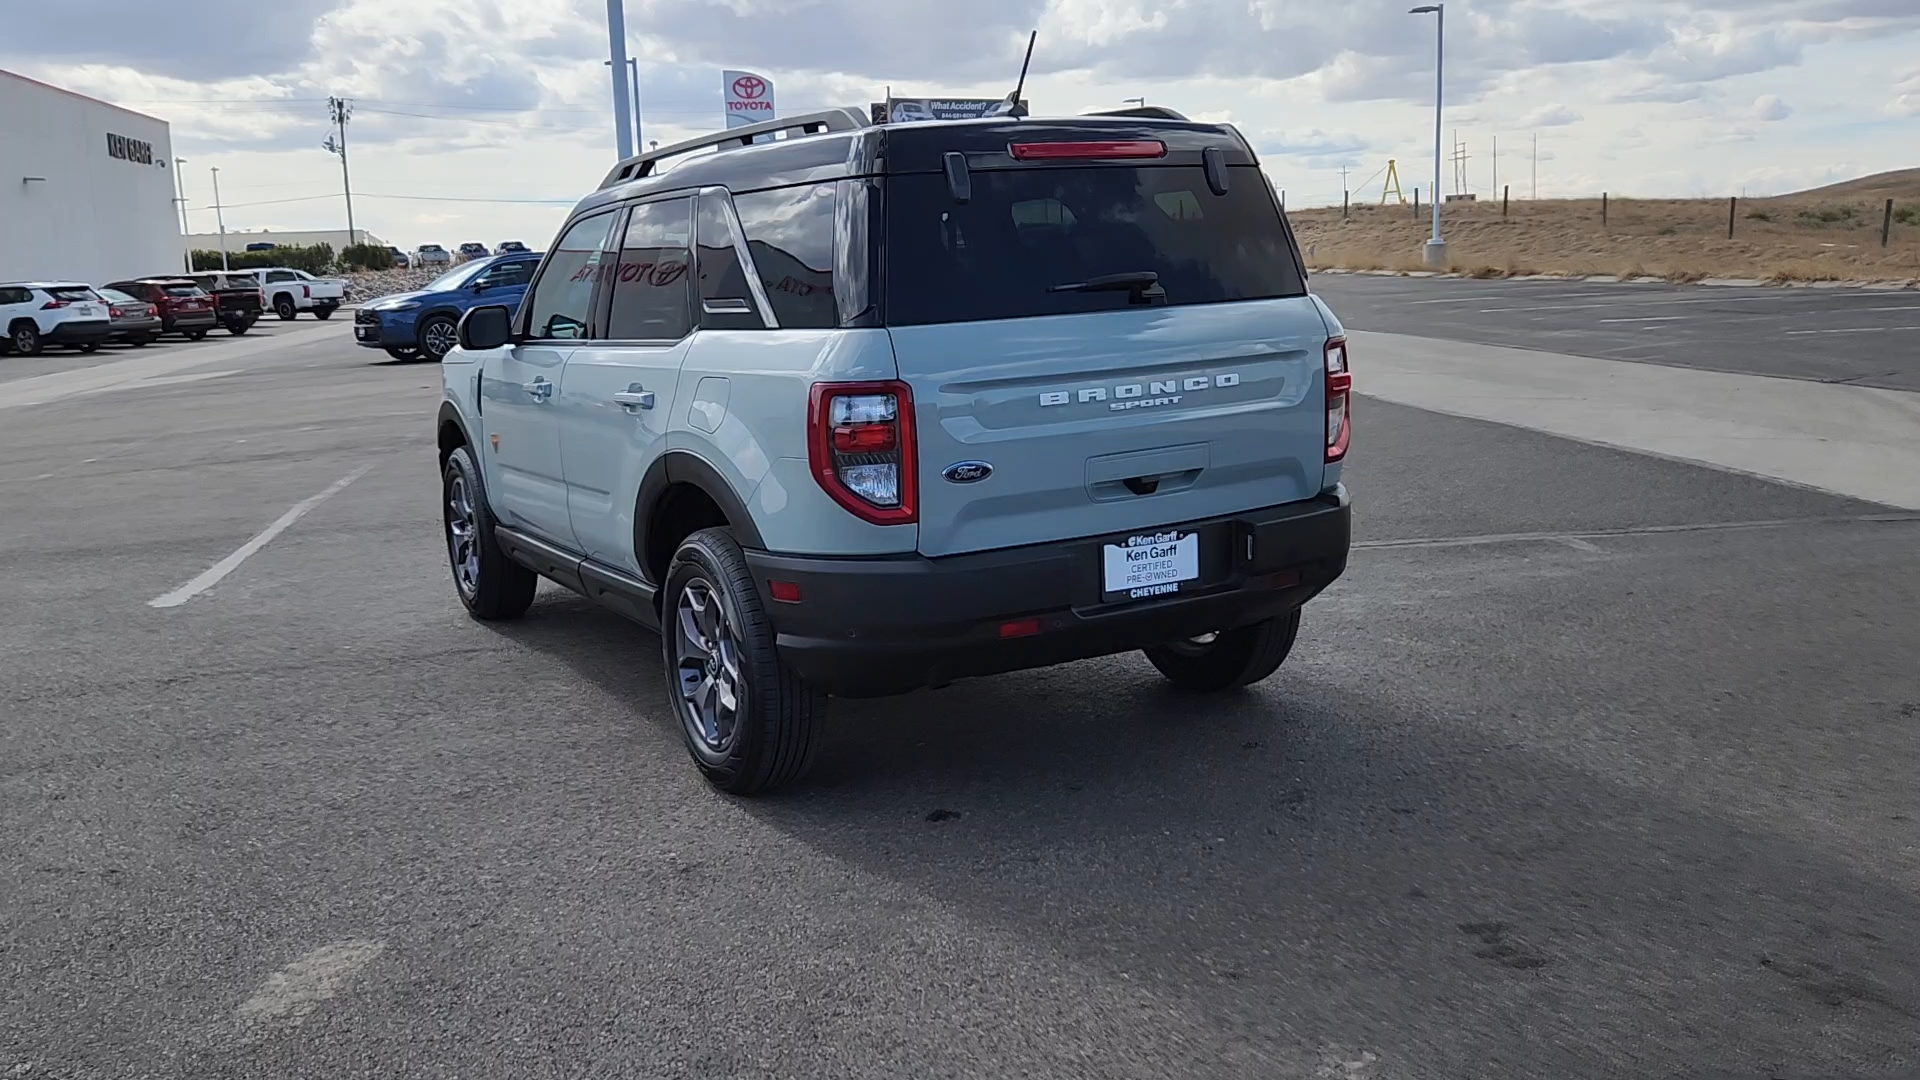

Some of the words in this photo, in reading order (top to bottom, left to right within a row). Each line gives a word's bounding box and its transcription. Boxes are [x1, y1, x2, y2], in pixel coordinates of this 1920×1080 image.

[727, 101, 772, 111] TOYOTA
[931, 101, 950, 110] What
[950, 101, 987, 111] Accident?
[106, 132, 126, 159] KEN
[1039, 373, 1239, 407] BRONCO
[1109, 395, 1182, 411] SPORT
[955, 465, 982, 479] Ford
[1136, 536, 1155, 546] Ken
[1155, 531, 1177, 543] Garff
[1126, 549, 1148, 562] Ken
[1149, 544, 1177, 558] Garff
[1131, 560, 1173, 573] CERTIFIED
[1130, 583, 1178, 598] CHEYENNE
